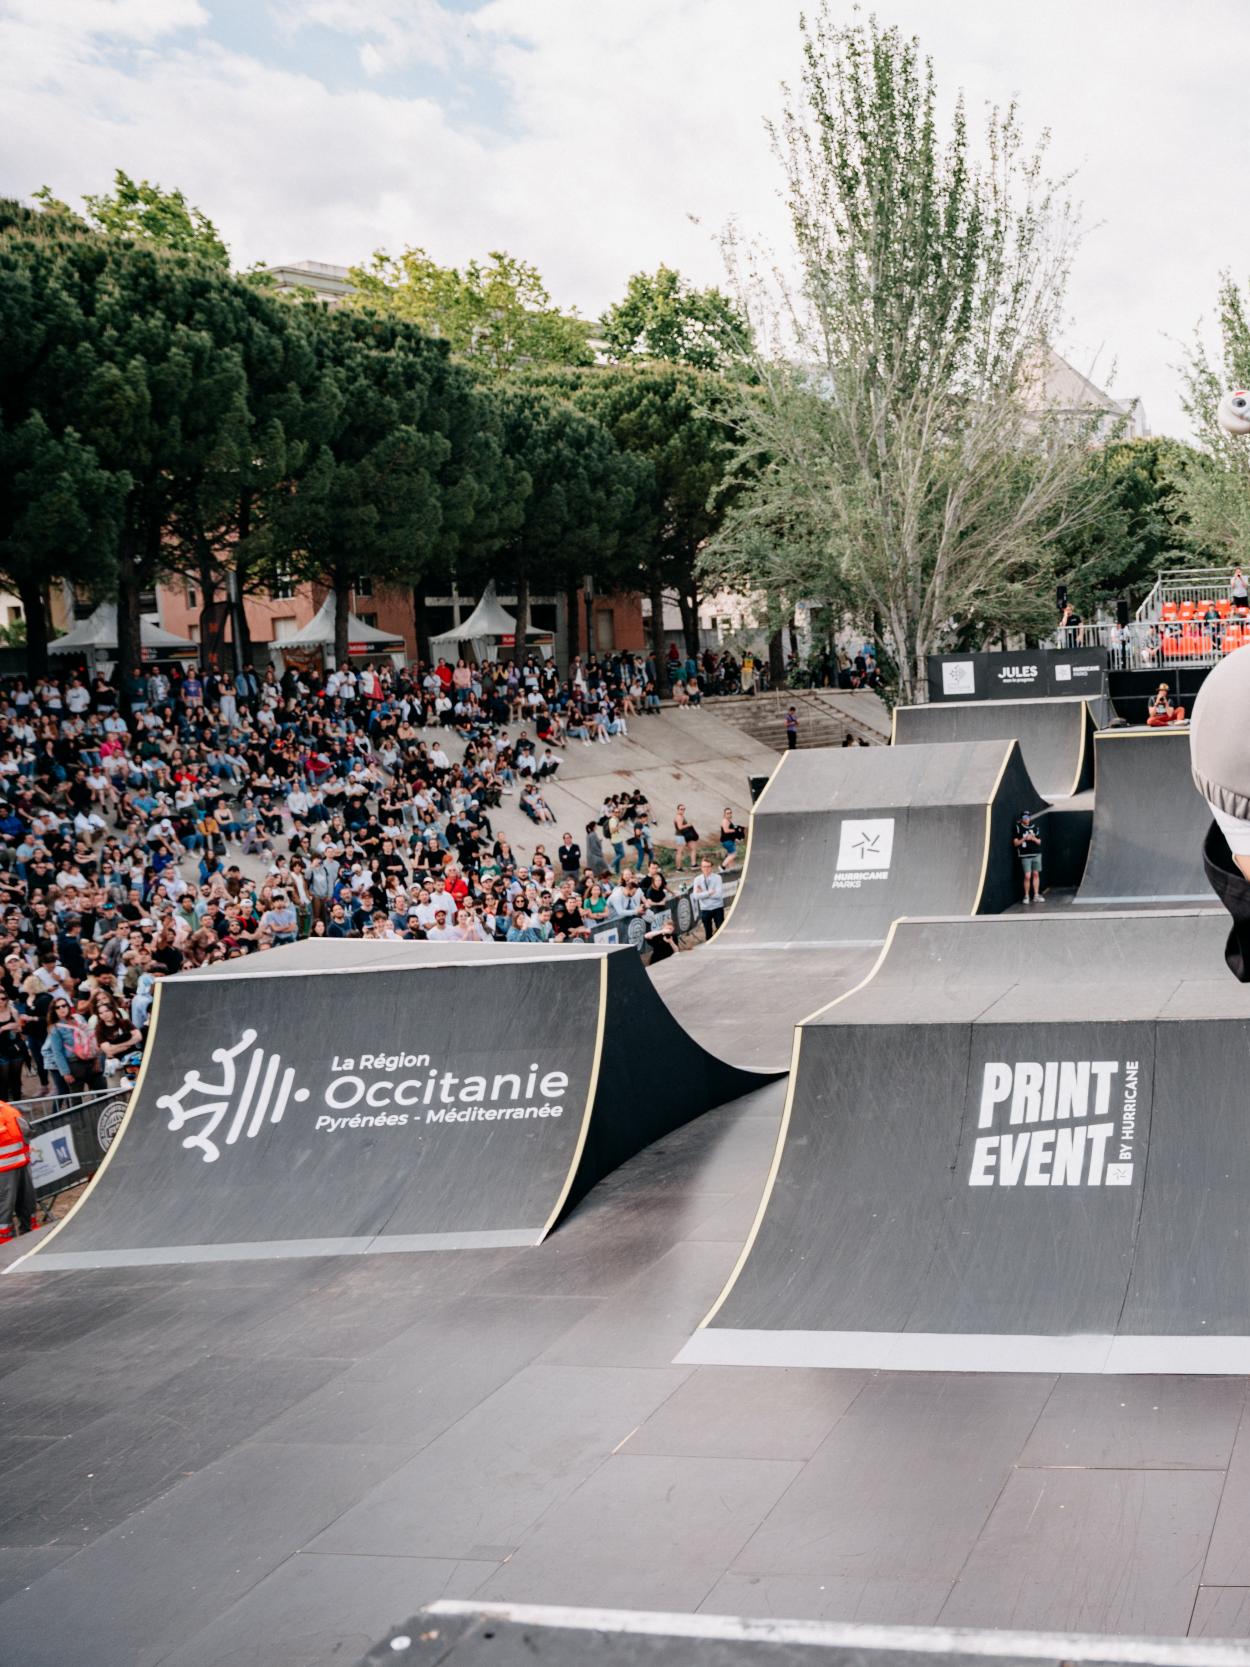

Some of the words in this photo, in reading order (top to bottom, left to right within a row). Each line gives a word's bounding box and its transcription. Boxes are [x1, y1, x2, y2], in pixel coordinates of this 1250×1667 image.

[998, 666, 1038, 679] JULES
[831, 880, 862, 889] PARKS
[833, 871, 889, 881] HURRICANE
[331, 1056, 355, 1072] La
[359, 1051, 430, 1072] Région
[324, 1063, 569, 1110] Occitanie
[978, 1061, 1119, 1129] PRINT
[1121, 1061, 1139, 1140] HURRICANE
[315, 1112, 409, 1132] Pyrénées
[425, 1103, 564, 1124] Méditerranée
[968, 1122, 1115, 1186] EVENT
[1119, 1144, 1133, 1160] BY
